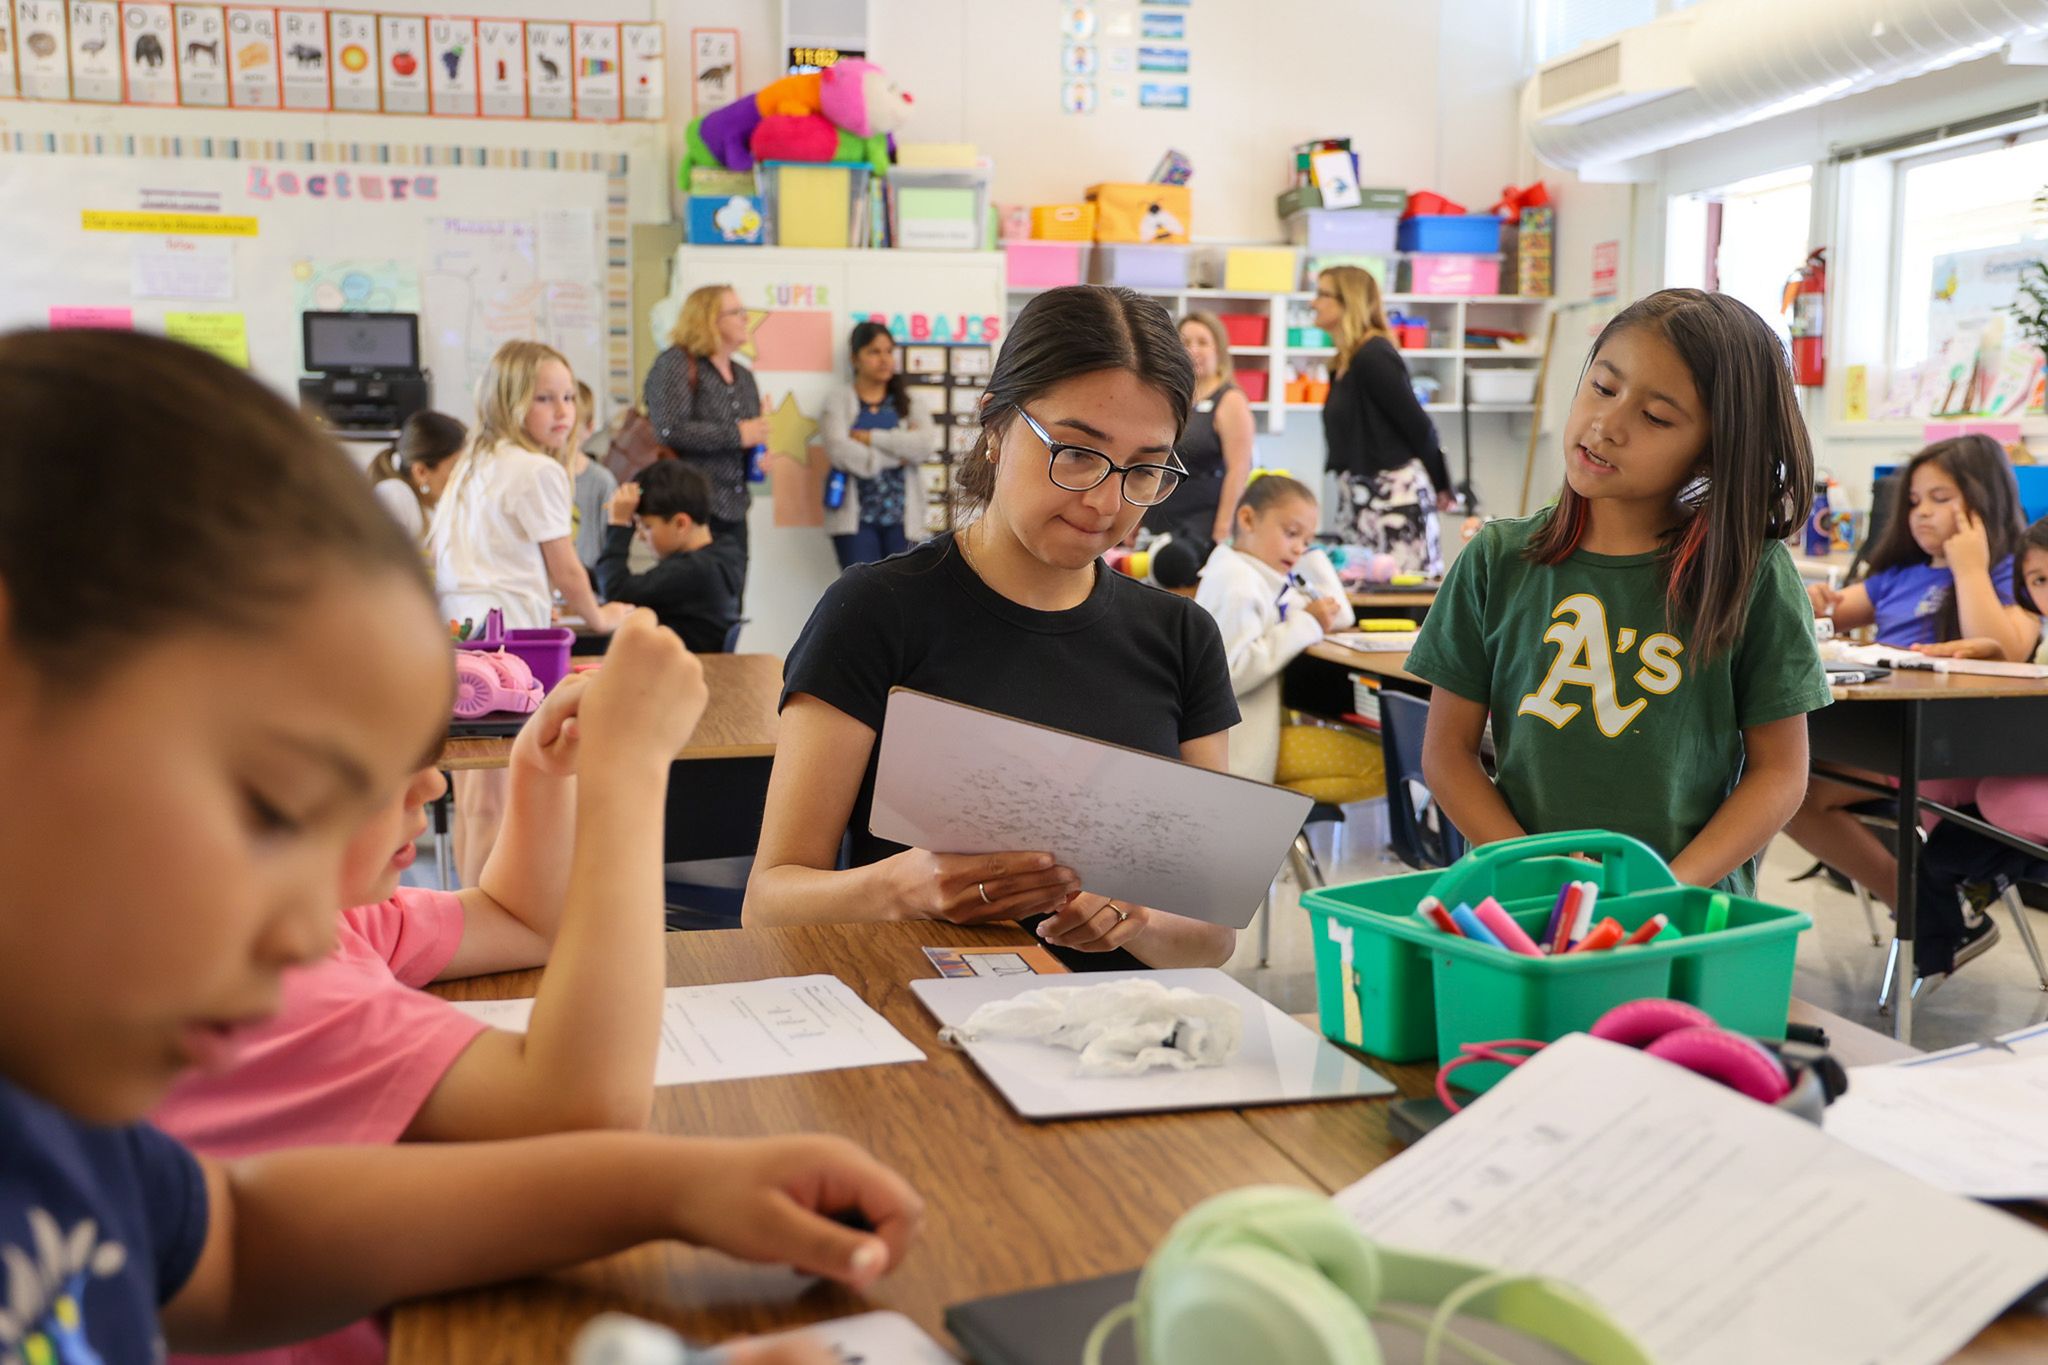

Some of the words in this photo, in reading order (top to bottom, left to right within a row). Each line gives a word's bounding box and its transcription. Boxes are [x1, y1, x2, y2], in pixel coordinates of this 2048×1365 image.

[20, 3, 38, 20] N
[126, 8, 147, 29] O
[182, 10, 196, 28] P
[230, 13, 250, 34] Q
[246, 164, 439, 200] Lectura
[763, 284, 830, 306] SUPER
[1516, 592, 1685, 738] A's
